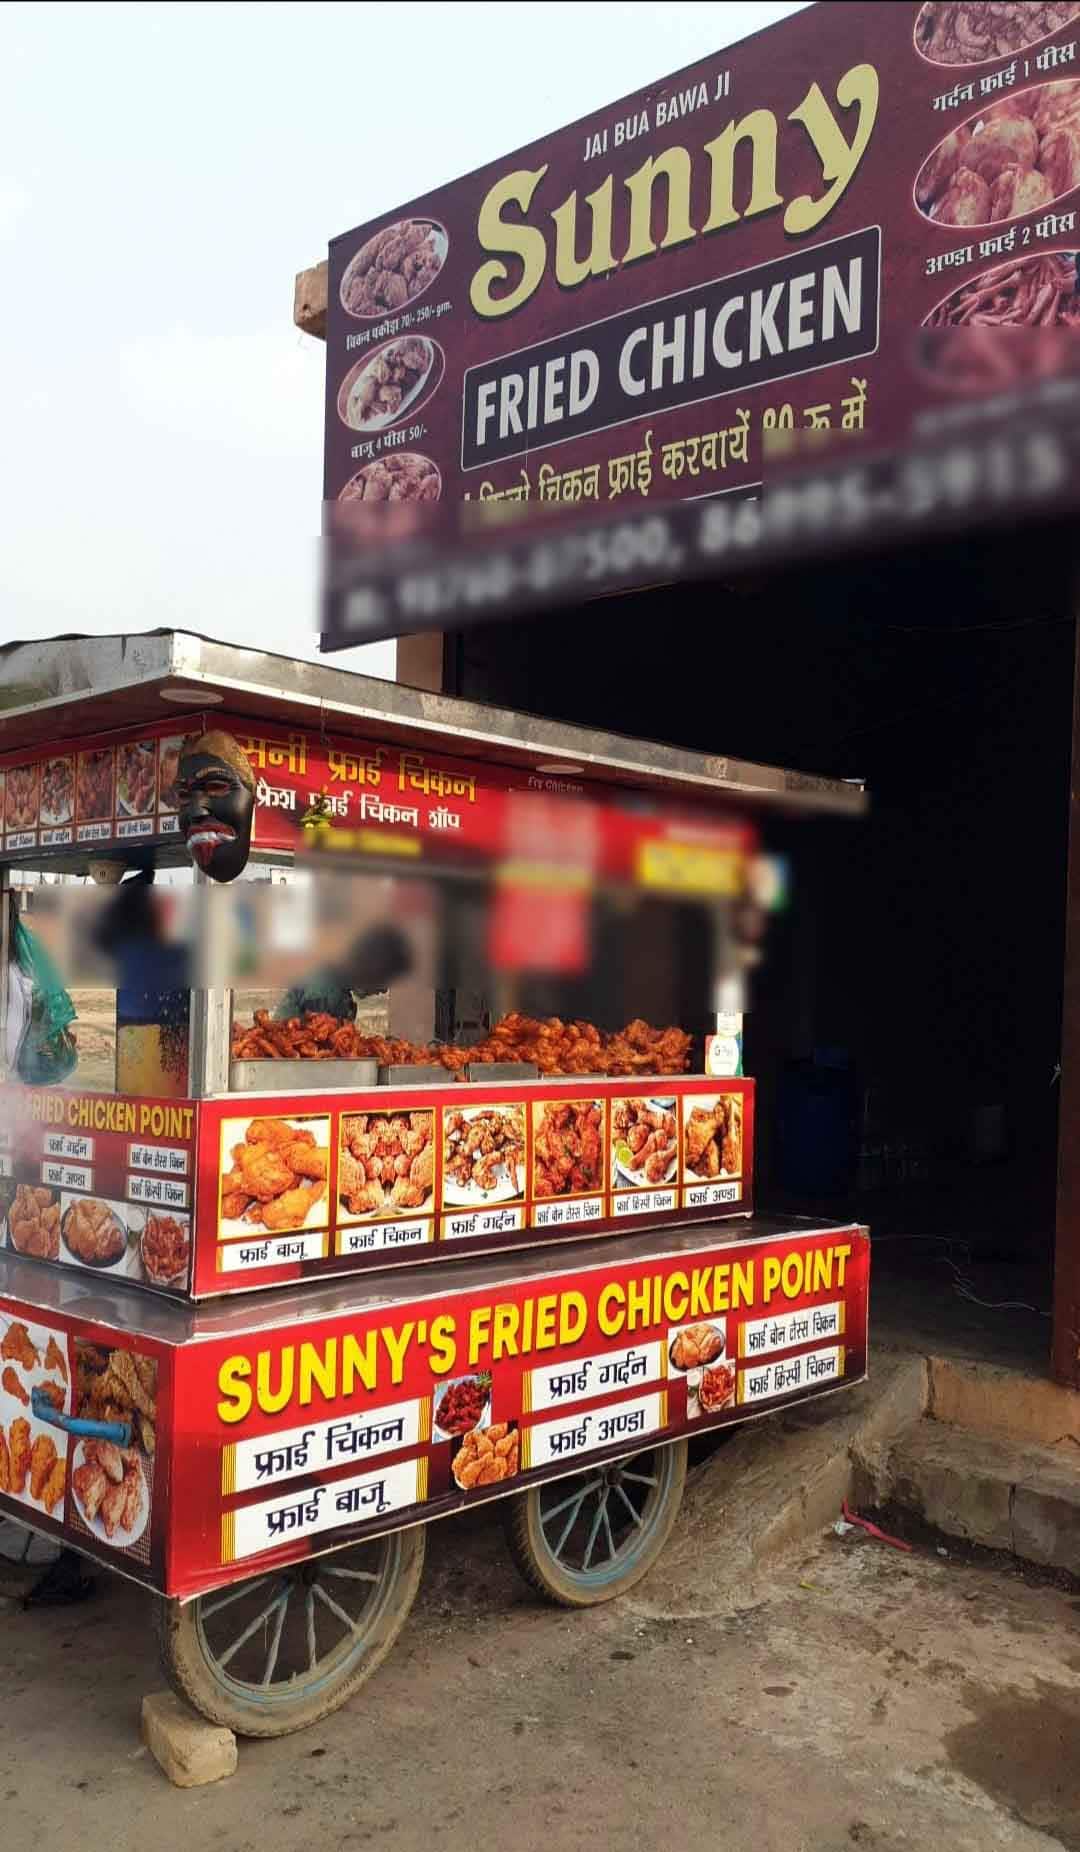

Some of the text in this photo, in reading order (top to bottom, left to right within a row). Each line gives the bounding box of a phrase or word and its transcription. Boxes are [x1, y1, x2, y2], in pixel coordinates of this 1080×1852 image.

[933, 83, 976, 112] गर्दन
[980, 61, 1018, 97] फ्राई
[1036, 41, 1077, 72] पीस
[583, 71, 731, 161] JAI BUA BAWA JI
[469, 63, 880, 318] Sunny
[925, 211, 1077, 275] अण्डा फ्राई 2 पीस
[476, 256, 863, 446] FRIED CHICKEN
[409, 422, 428, 441] 50/-
[607, 429, 653, 500] फ्राई
[661, 407, 751, 481] करवायें
[841, 376, 868, 431] में
[398, 754, 478, 802] चिकन
[360, 792, 419, 828] चिकन
[428, 805, 461, 829] शॉप
[20, 1093, 194, 1140] RIED CHICKEN POINT
[349, 1226, 422, 1250] फ्राई चिकन
[451, 1208, 516, 1235] फ्राई गर्दन
[239, 1240, 272, 1263] फ्राई
[216, 1244, 852, 1424] SUNNY'S FRIED CHICKEN POINT
[812, 1311, 837, 1336] चिकन
[549, 1350, 648, 1400] फ्राई गर्दन
[805, 1355, 836, 1380] चिकन
[255, 1417, 405, 1480] फ्राई चिकन
[549, 1408, 646, 1457] फ्राई अण्डा
[265, 1480, 391, 1538] फ्राई बाजू
